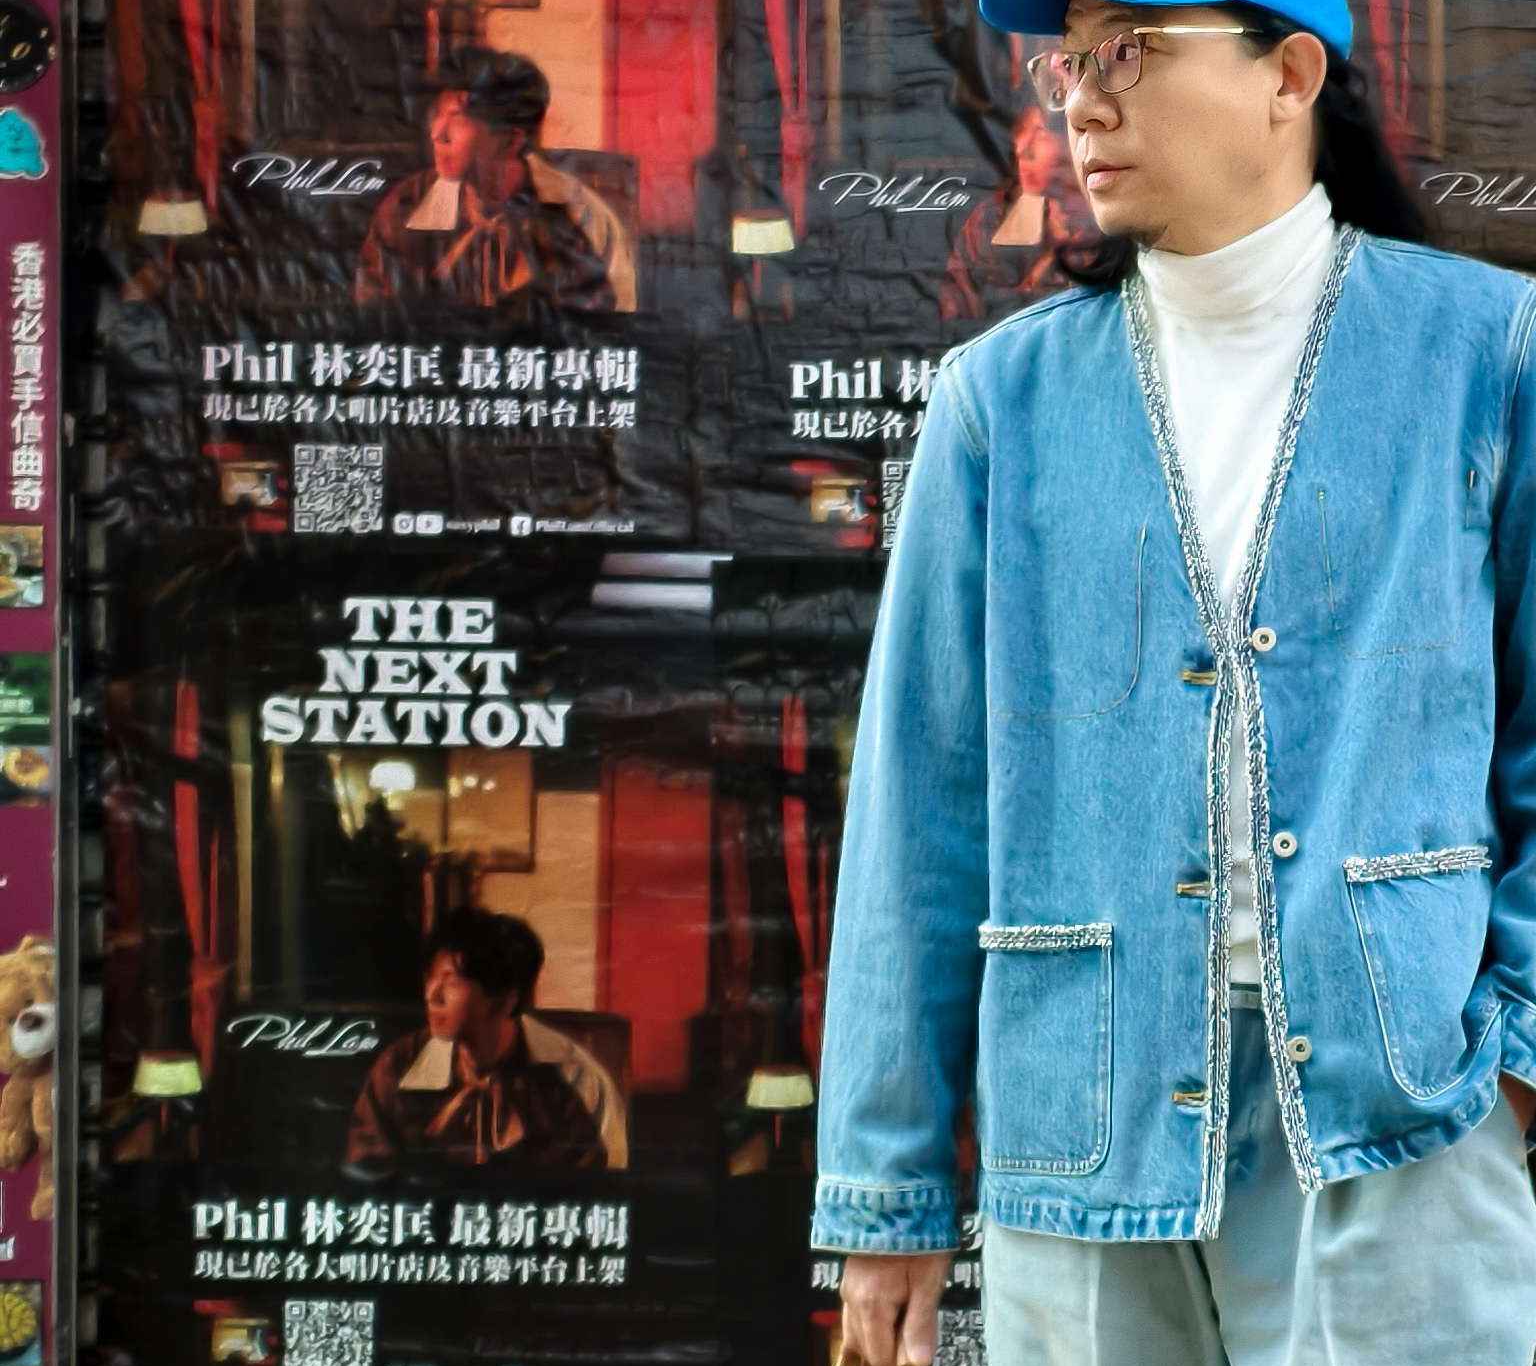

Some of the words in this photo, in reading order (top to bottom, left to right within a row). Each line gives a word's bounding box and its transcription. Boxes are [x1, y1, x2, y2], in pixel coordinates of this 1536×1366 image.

[232, 154, 332, 188] Phil
[819, 172, 914, 209] Phil
[1420, 172, 1519, 208] Phil
[10, 240, 46, 513] 香港必買手信曲奇
[202, 342, 294, 383] Phil
[310, 343, 443, 387] 林奕匡
[458, 346, 638, 391] 最新專輯
[789, 359, 883, 400] Phil
[342, 596, 495, 644] THE
[318, 648, 517, 695] NEXT
[261, 696, 573, 748] STATION
[227, 1013, 331, 1052] Phil
[192, 1199, 286, 1242] Phil
[301, 1199, 436, 1247] 林奕匡
[449, 1202, 628, 1248] 最新專輯
